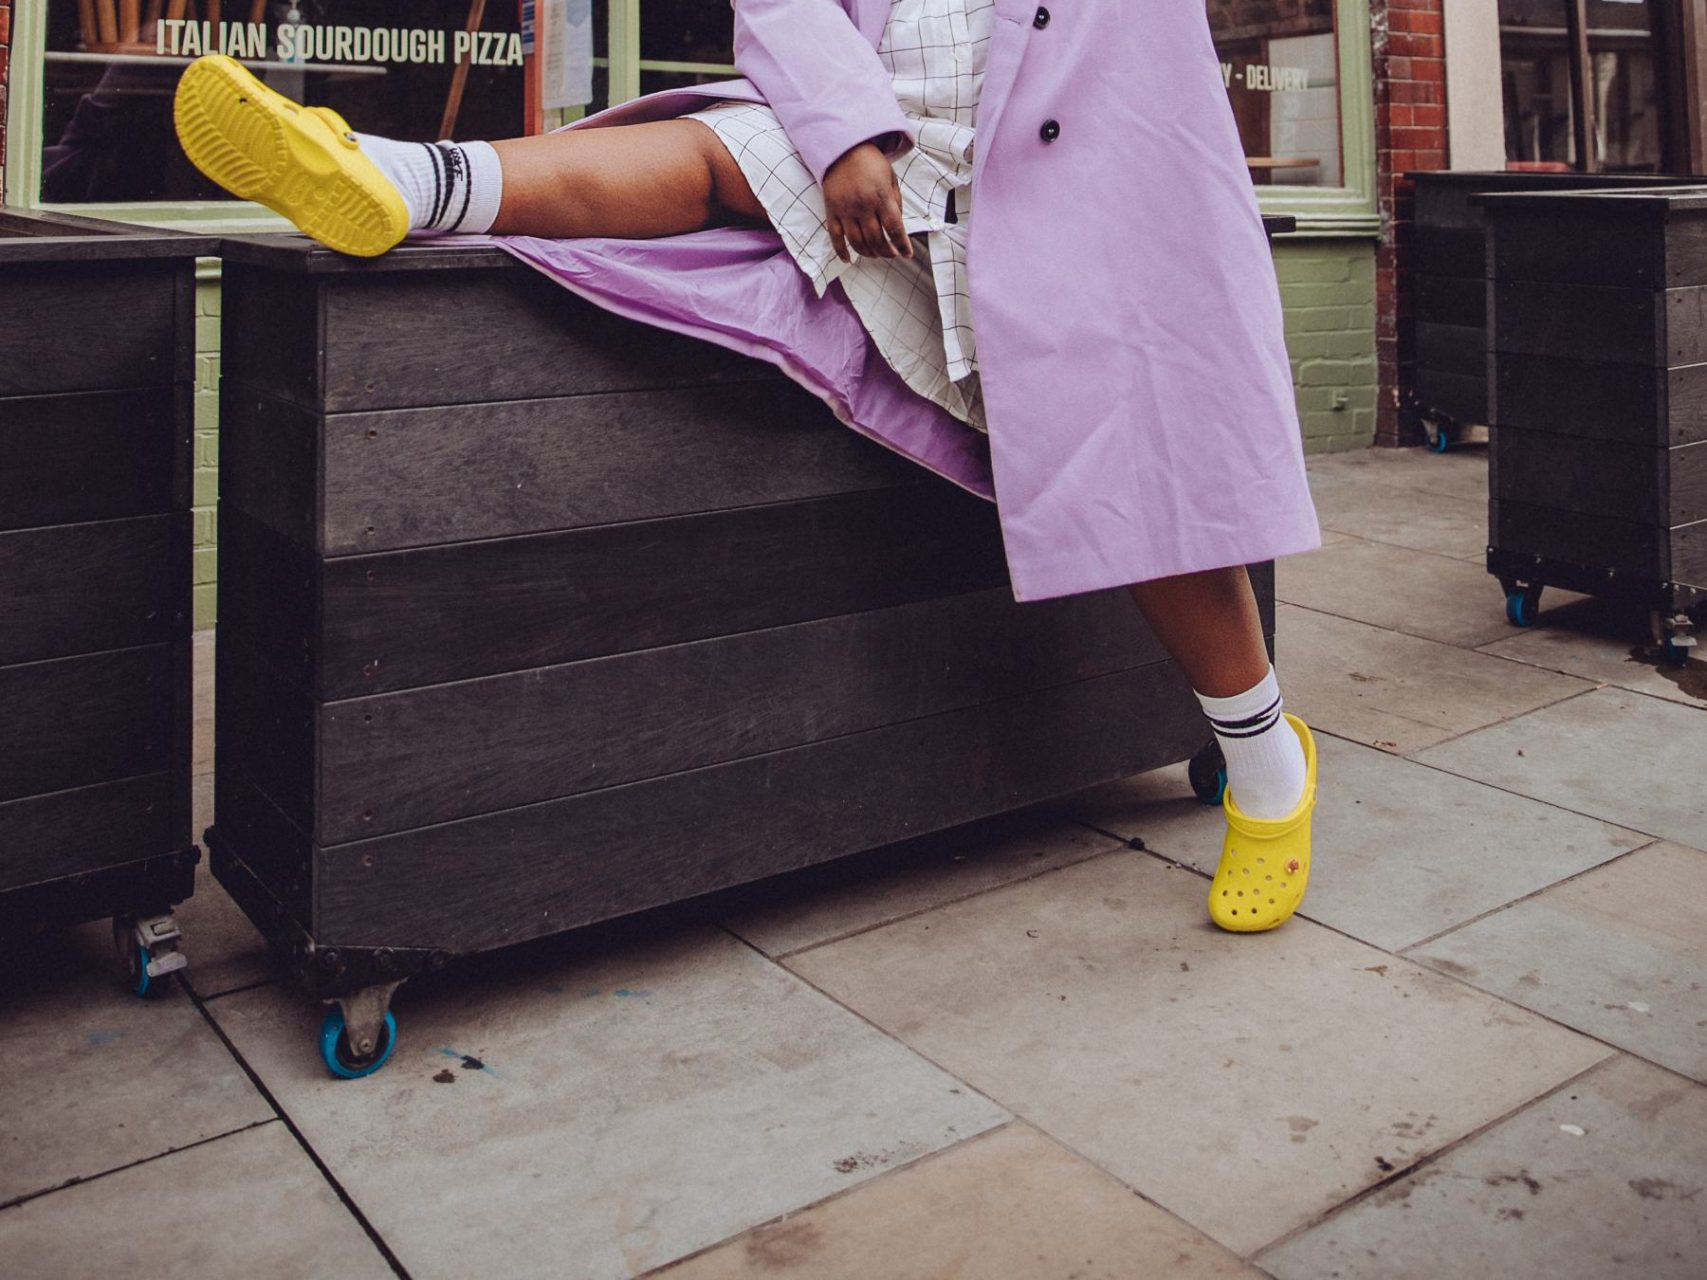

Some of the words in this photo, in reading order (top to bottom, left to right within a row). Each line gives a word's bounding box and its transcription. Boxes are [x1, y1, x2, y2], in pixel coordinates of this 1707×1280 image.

[156, 19, 267, 58] ITALIAN
[277, 23, 445, 63] SOURDOUGH
[453, 30, 524, 66] PIZZA
[1246, 63, 1310, 92] DELIVERY
